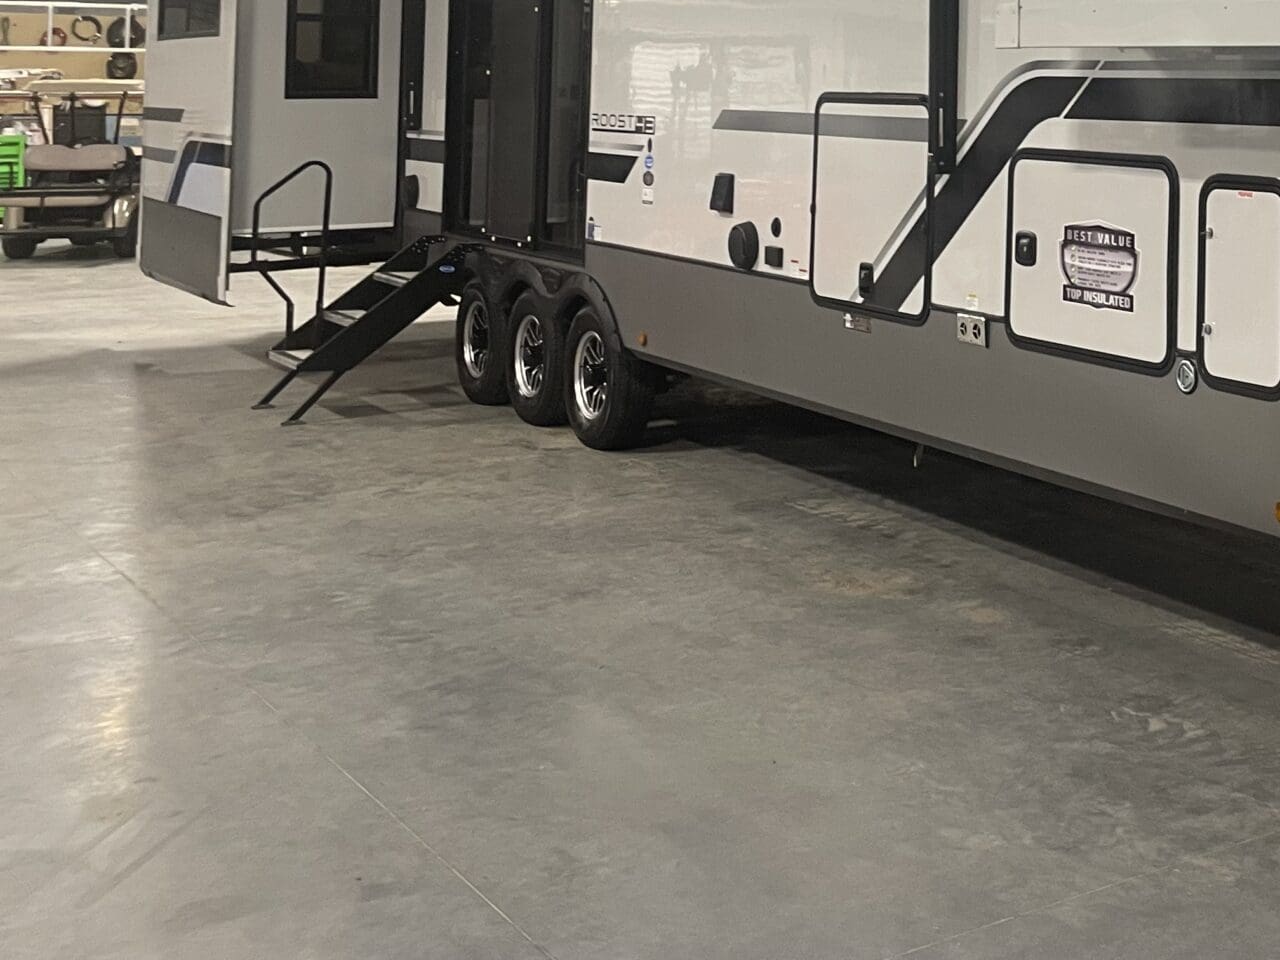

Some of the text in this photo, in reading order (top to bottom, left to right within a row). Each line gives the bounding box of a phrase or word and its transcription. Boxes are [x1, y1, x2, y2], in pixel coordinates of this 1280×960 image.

[1066, 229, 1132, 248] BEST VALUE
[1066, 288, 1131, 308] TOP INSULATED
